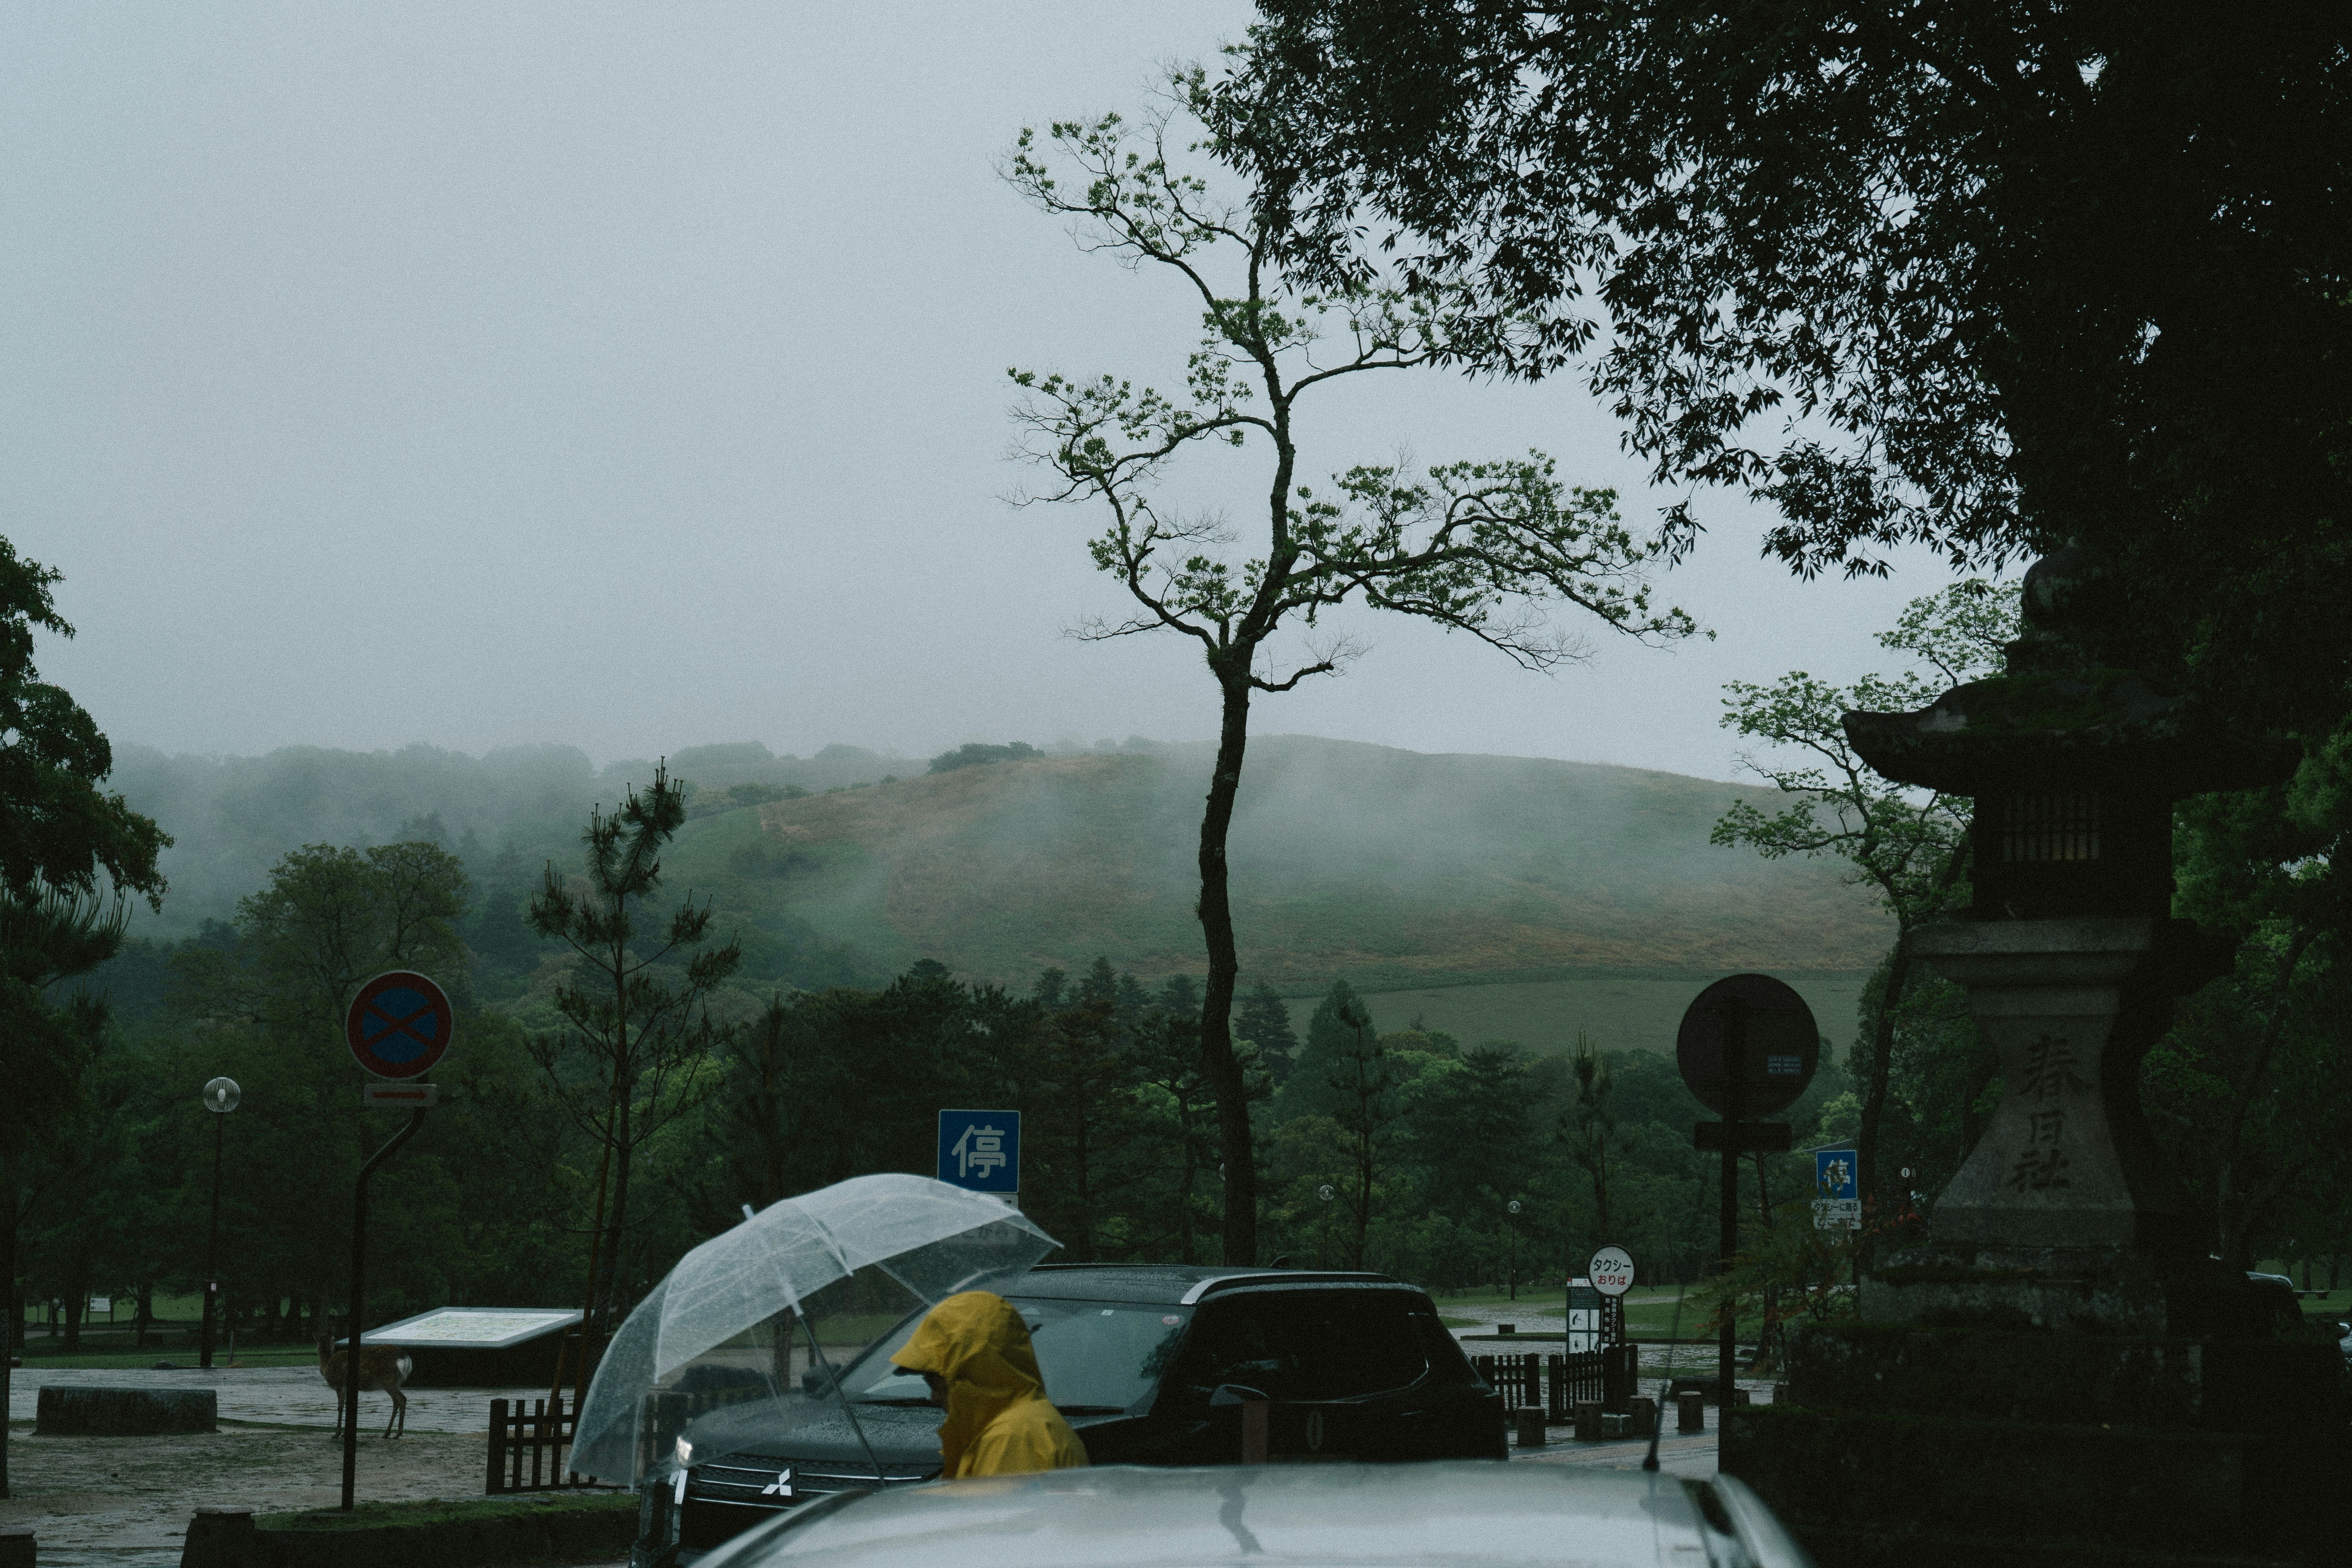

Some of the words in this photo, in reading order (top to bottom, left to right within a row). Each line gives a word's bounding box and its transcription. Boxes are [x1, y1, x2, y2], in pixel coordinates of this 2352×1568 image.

[951, 1124, 1006, 1178] 停
[1823, 1159, 1850, 1191] 停
[1815, 1202, 1858, 1212] タクシーに限る
[1594, 1259, 1631, 1272] タクシー
[1598, 1275, 1627, 1285] おりば
